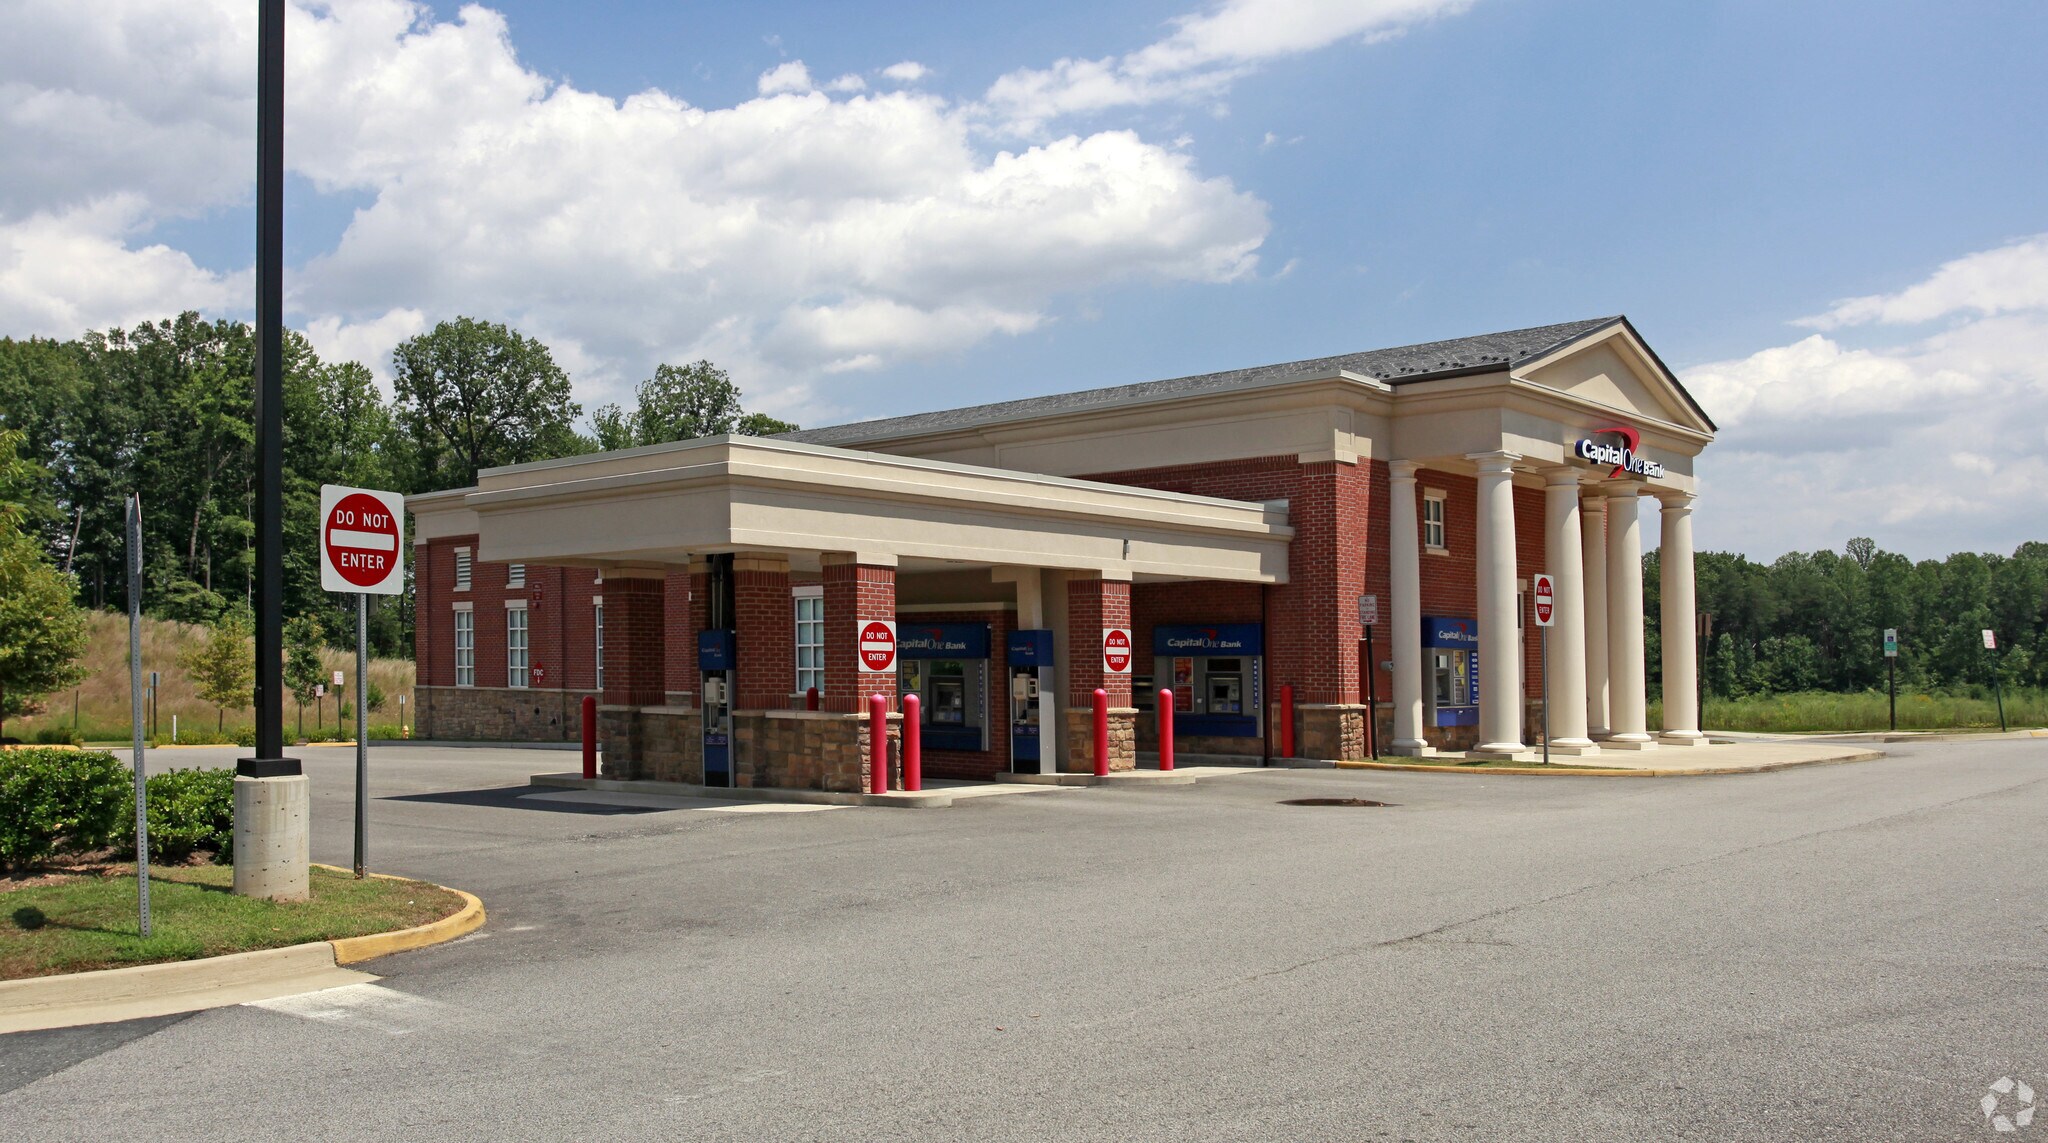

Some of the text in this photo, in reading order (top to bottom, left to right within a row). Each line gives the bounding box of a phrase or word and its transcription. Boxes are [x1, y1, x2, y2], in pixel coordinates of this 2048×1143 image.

[1643, 460, 1665, 478] Bank
[336, 509, 388, 528] DO NOT
[341, 552, 384, 569] ENTER
[1537, 585, 1551, 594] DO NOT
[1538, 606, 1550, 614] ENTER
[876, 632, 888, 640] NOT
[945, 642, 966, 650] Bank
[868, 653, 887, 661] ENTER
[1110, 656, 1125, 664] ENTER
[533, 668, 544, 676] FDC
